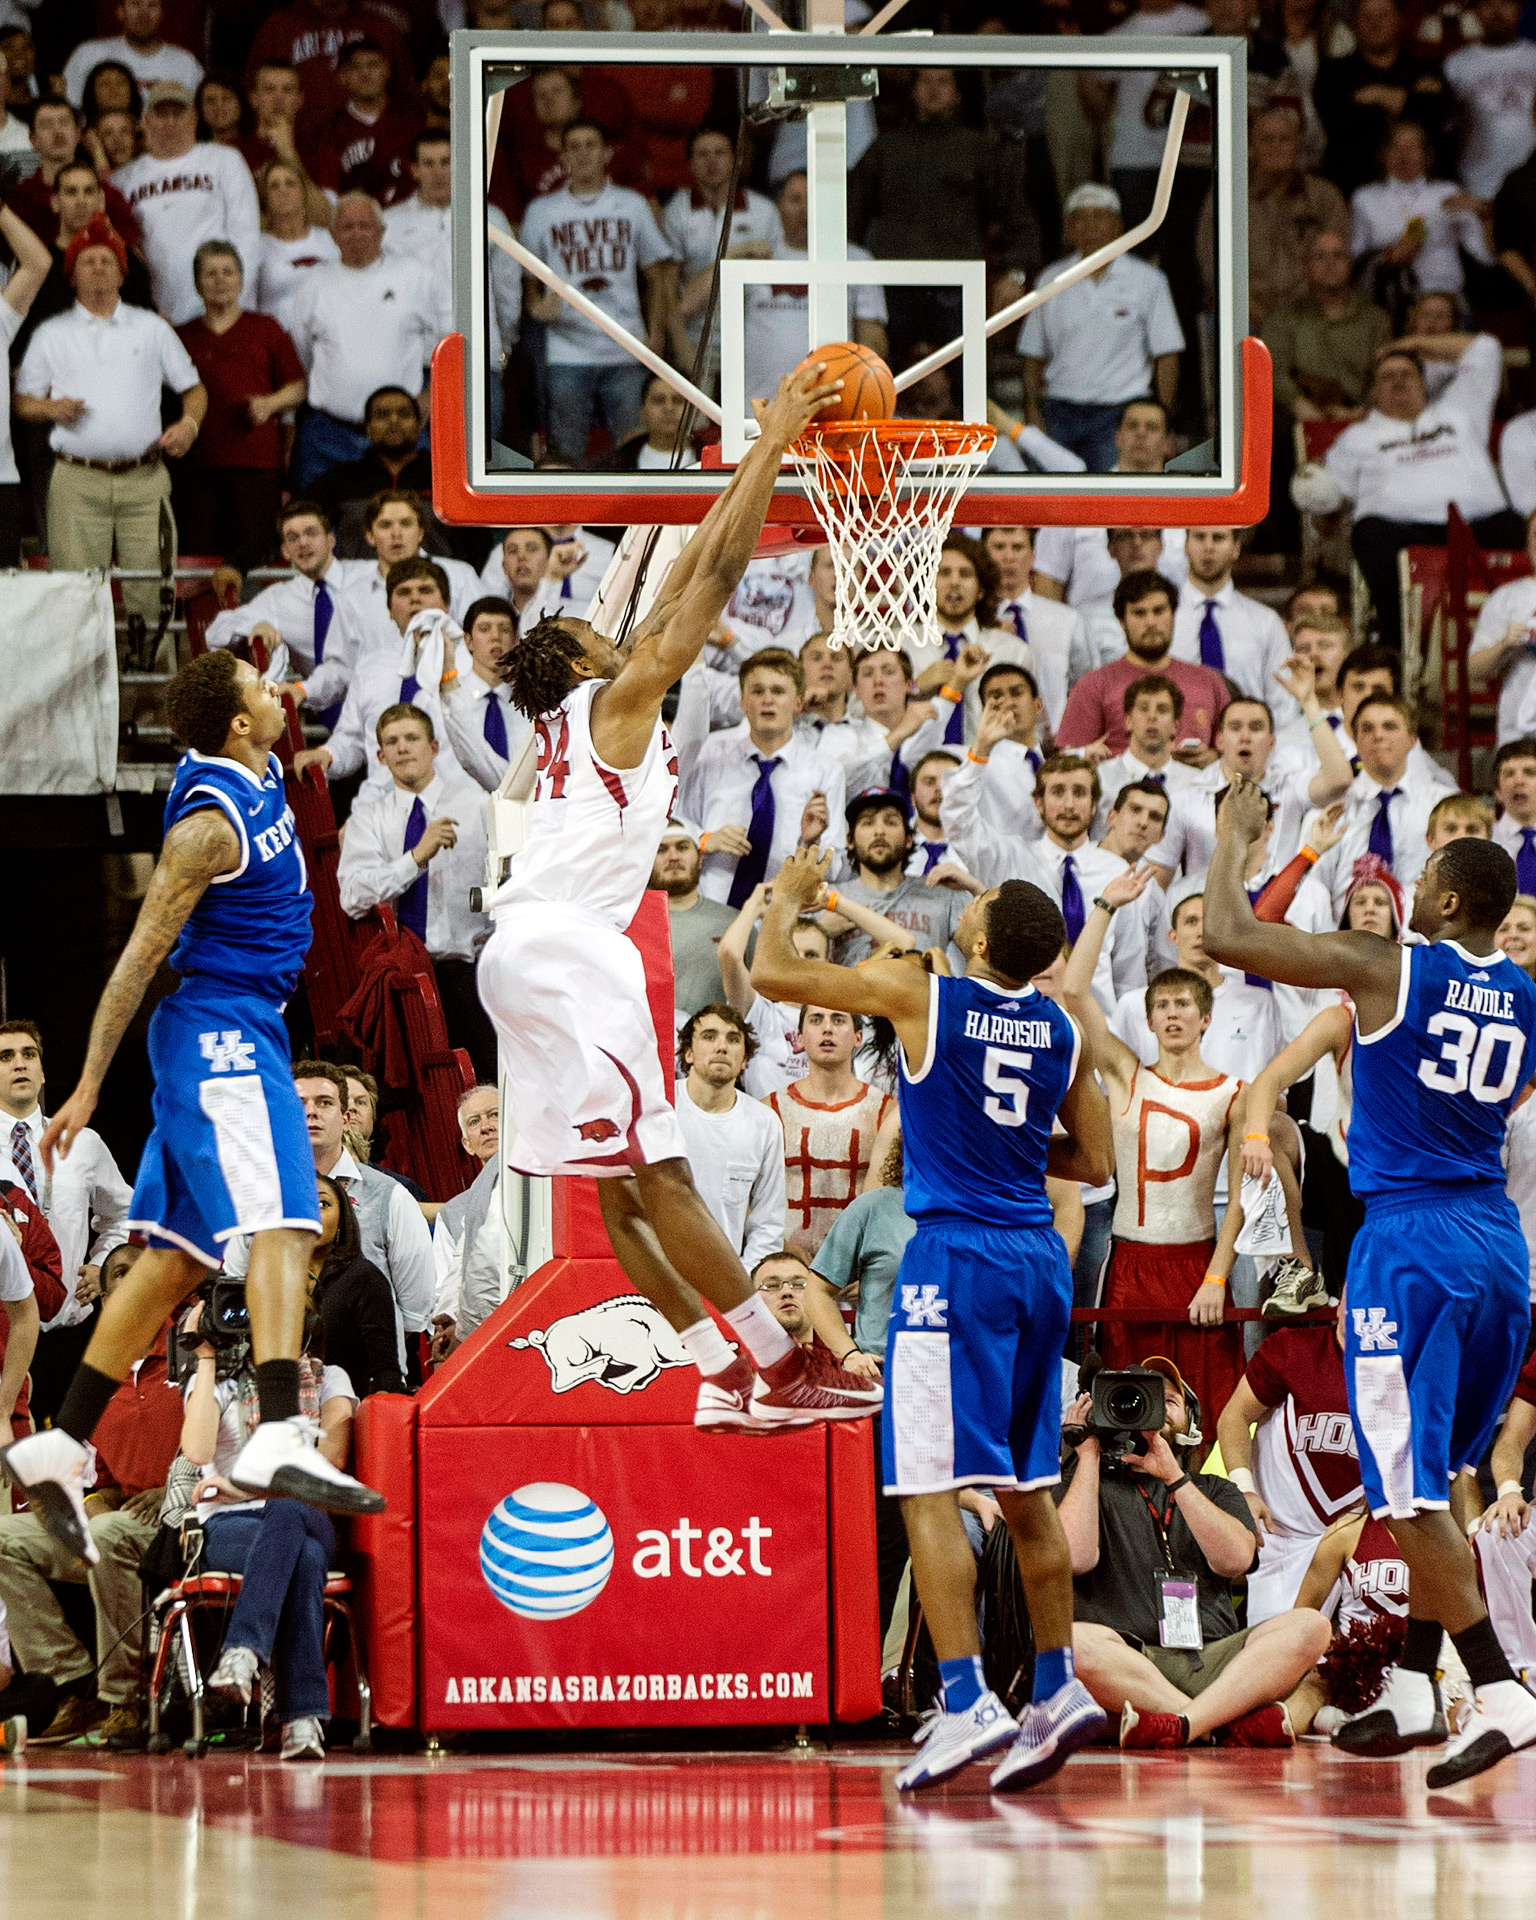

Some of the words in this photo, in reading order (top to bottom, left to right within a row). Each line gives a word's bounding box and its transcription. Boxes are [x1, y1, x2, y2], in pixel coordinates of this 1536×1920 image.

[551, 217, 631, 248] NEVER
[561, 244, 626, 274] YIELD
[1444, 979, 1514, 1019] RANDLE
[964, 1009, 1051, 1048] HARRISON
[198, 1030, 256, 1072] UK
[1417, 1011, 1526, 1103] 30
[982, 1046, 1033, 1127] 5
[1137, 1098, 1201, 1227] P
[901, 1284, 948, 1327] UK
[1351, 1306, 1398, 1351] UK
[632, 1516, 773, 1578] at&t
[445, 1672, 814, 1704] ARKANSASRAZORBACKS.COM
